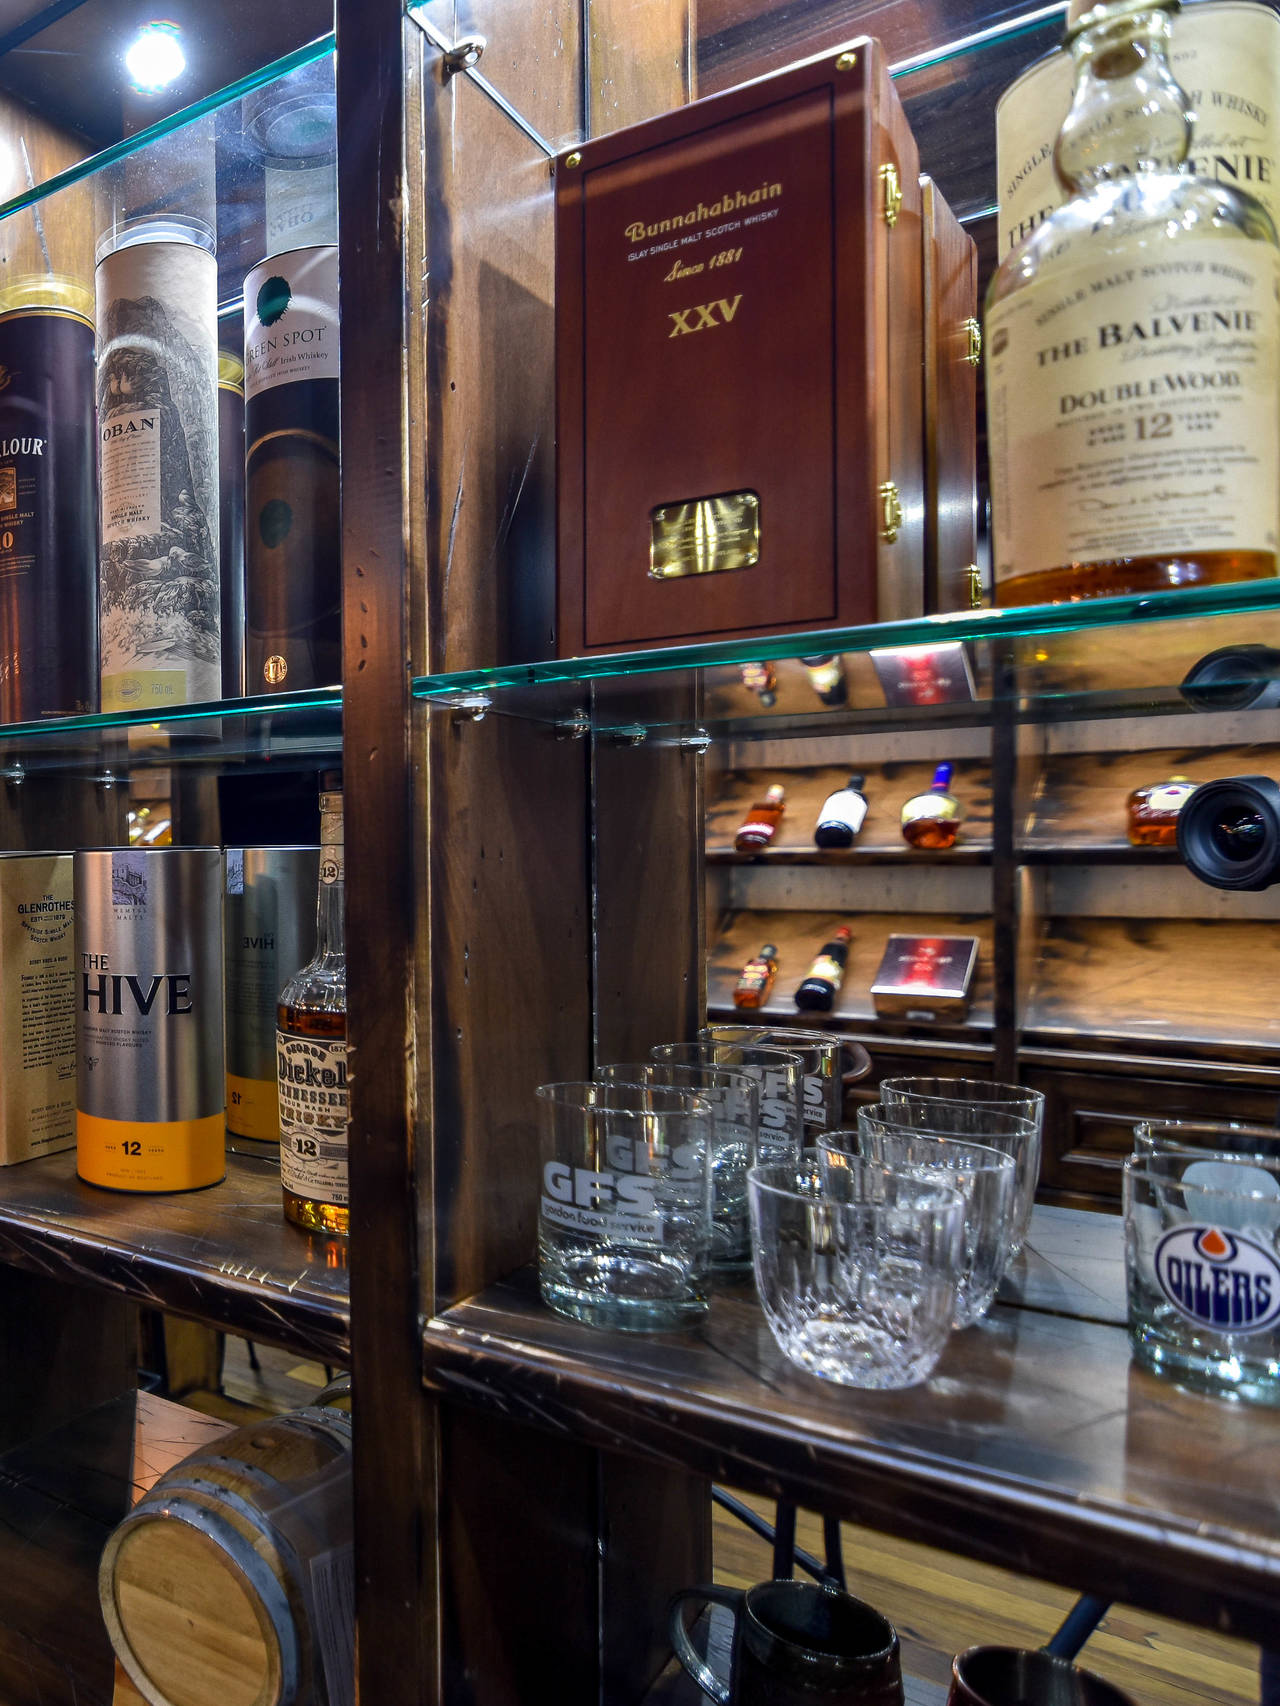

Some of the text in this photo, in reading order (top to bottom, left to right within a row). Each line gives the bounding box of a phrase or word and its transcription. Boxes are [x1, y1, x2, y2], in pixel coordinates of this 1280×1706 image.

[1007, 143, 1052, 198] SINGLE
[625, 182, 783, 242] Bunnahabhain
[627, 208, 780, 262] ISLAY SINGLE MALT SCOTCH WHISKY
[664, 247, 744, 282] Since 1881
[1090, 269, 1136, 293] MALT
[1141, 261, 1205, 278] SCOTCH
[668, 294, 744, 338] XXV
[283, 327, 326, 347] SPOT
[1037, 337, 1090, 367] THE
[1099, 310, 1260, 349] BALVENIE
[280, 355, 297, 364] Irish
[298, 351, 329, 362] Whiskey
[103, 417, 155, 442] OBAN
[1134, 412, 1173, 441] 12
[321, 866, 336, 878] 12
[17, 900, 74, 914] GLENROTHES
[81, 953, 109, 971] THE
[82, 973, 193, 1016] HIVE
[279, 1052, 348, 1089] Dickel
[280, 1081, 348, 1107] ENNESSEE
[305, 1104, 331, 1113] MASH
[121, 1140, 142, 1156] 12
[296, 1138, 317, 1157] 12
[544, 1161, 656, 1216] GFS
[545, 1204, 576, 1222] gordon
[578, 1211, 607, 1228] food
[1167, 1256, 1271, 1324] OILERS
